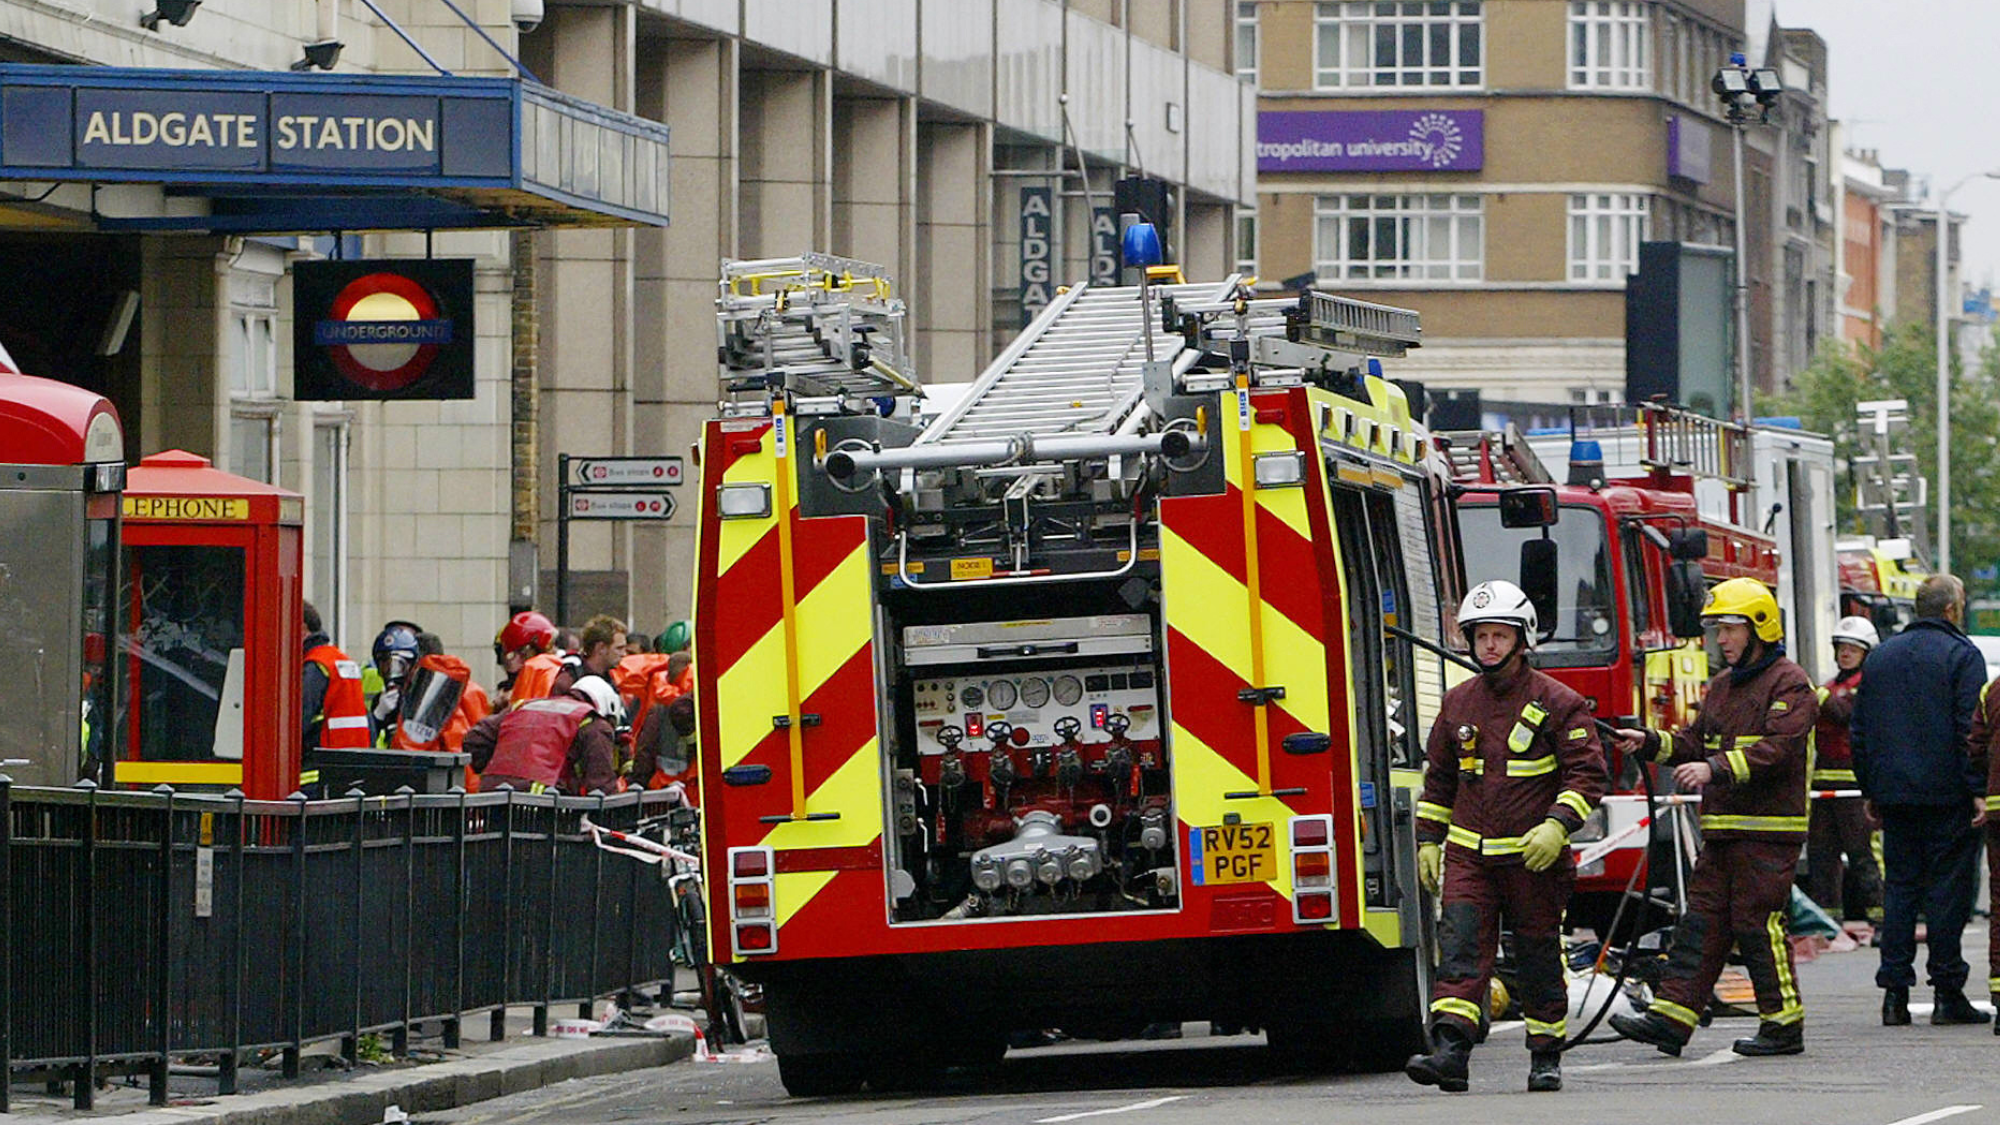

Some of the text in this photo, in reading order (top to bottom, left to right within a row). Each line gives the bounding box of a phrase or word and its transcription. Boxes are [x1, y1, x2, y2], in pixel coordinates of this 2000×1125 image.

[84, 112, 433, 151] ALDGATE STATION
[1347, 138, 1433, 161] university
[322, 325, 445, 339] UNDERGROUND
[1205, 827, 1271, 852] RV52
[1215, 855, 1263, 878] PGF
